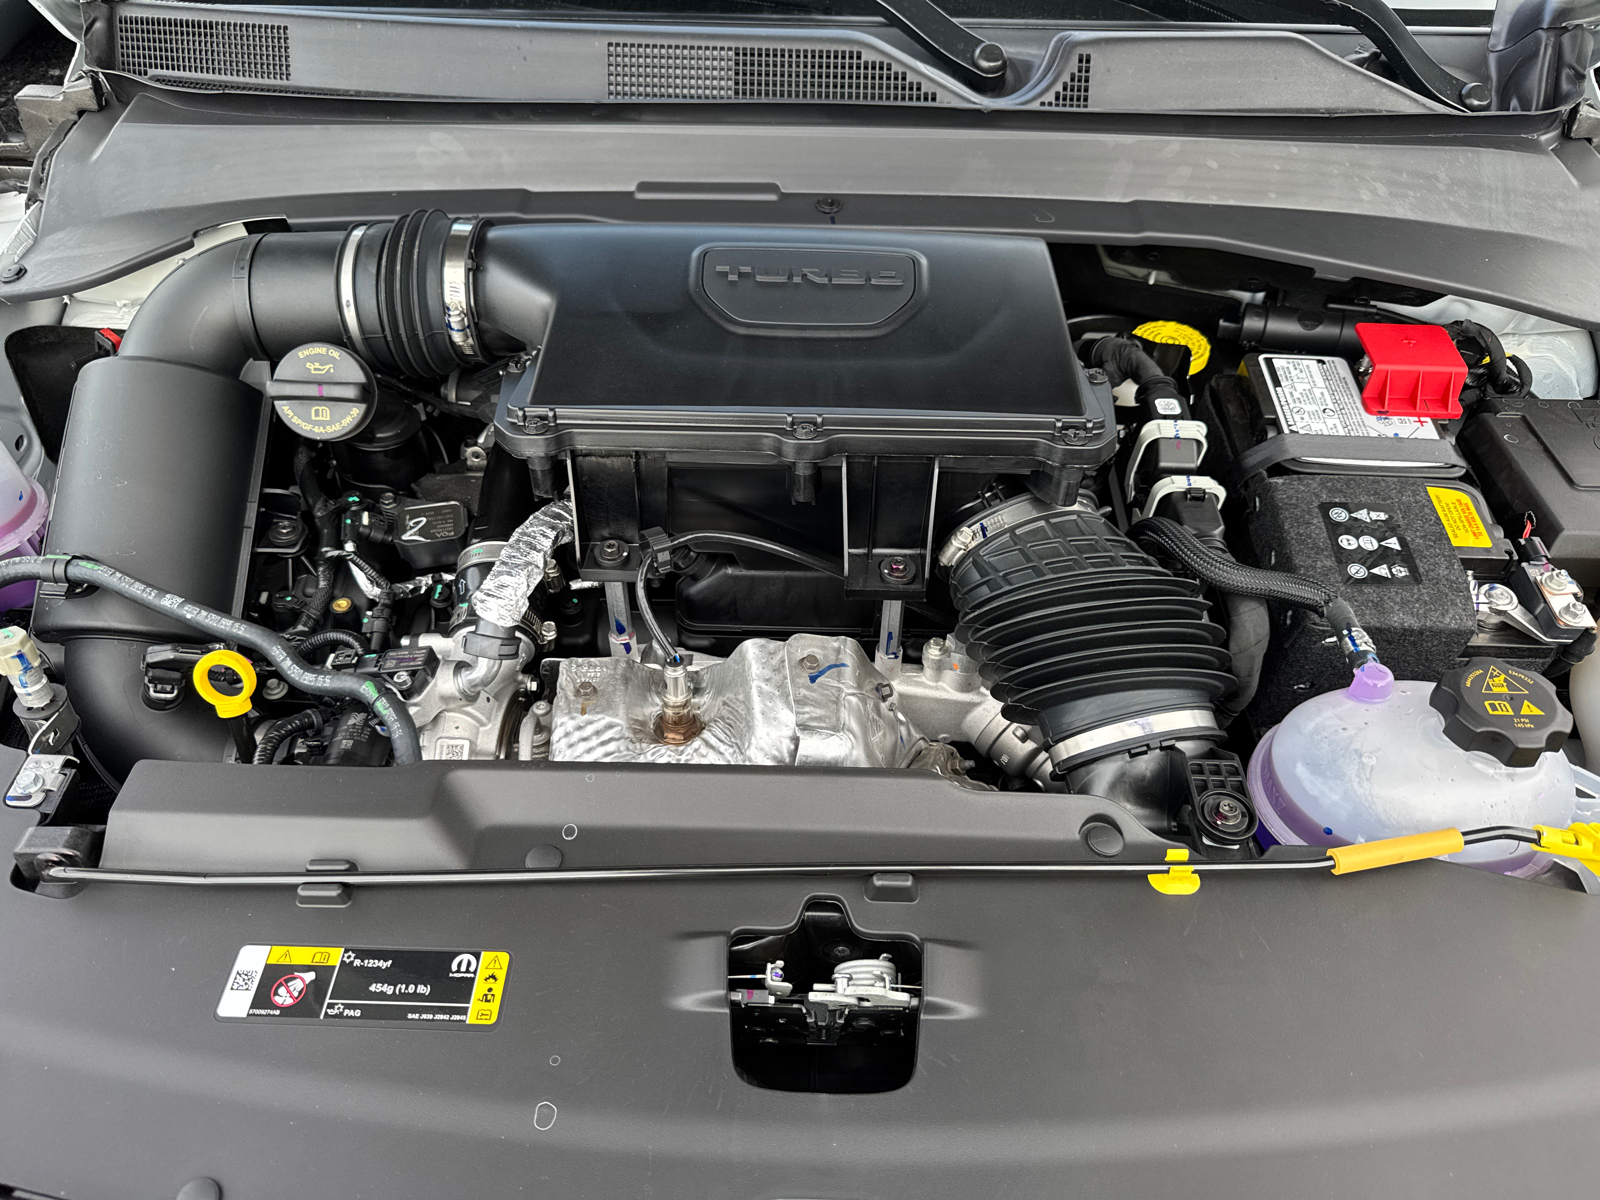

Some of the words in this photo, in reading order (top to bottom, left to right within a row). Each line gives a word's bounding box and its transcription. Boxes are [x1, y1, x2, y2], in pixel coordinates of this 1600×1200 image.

[715, 265, 904, 286] TURBO
[298, 347, 327, 359] ENGINE
[328, 349, 341, 360] OIL
[281, 405, 294, 419] API
[353, 959, 393, 970] R-1234yf
[369, 983, 394, 995] 454g
[395, 984, 415, 995] (1.0
[416, 984, 431, 996] lb)
[343, 1009, 362, 1018] PAG
